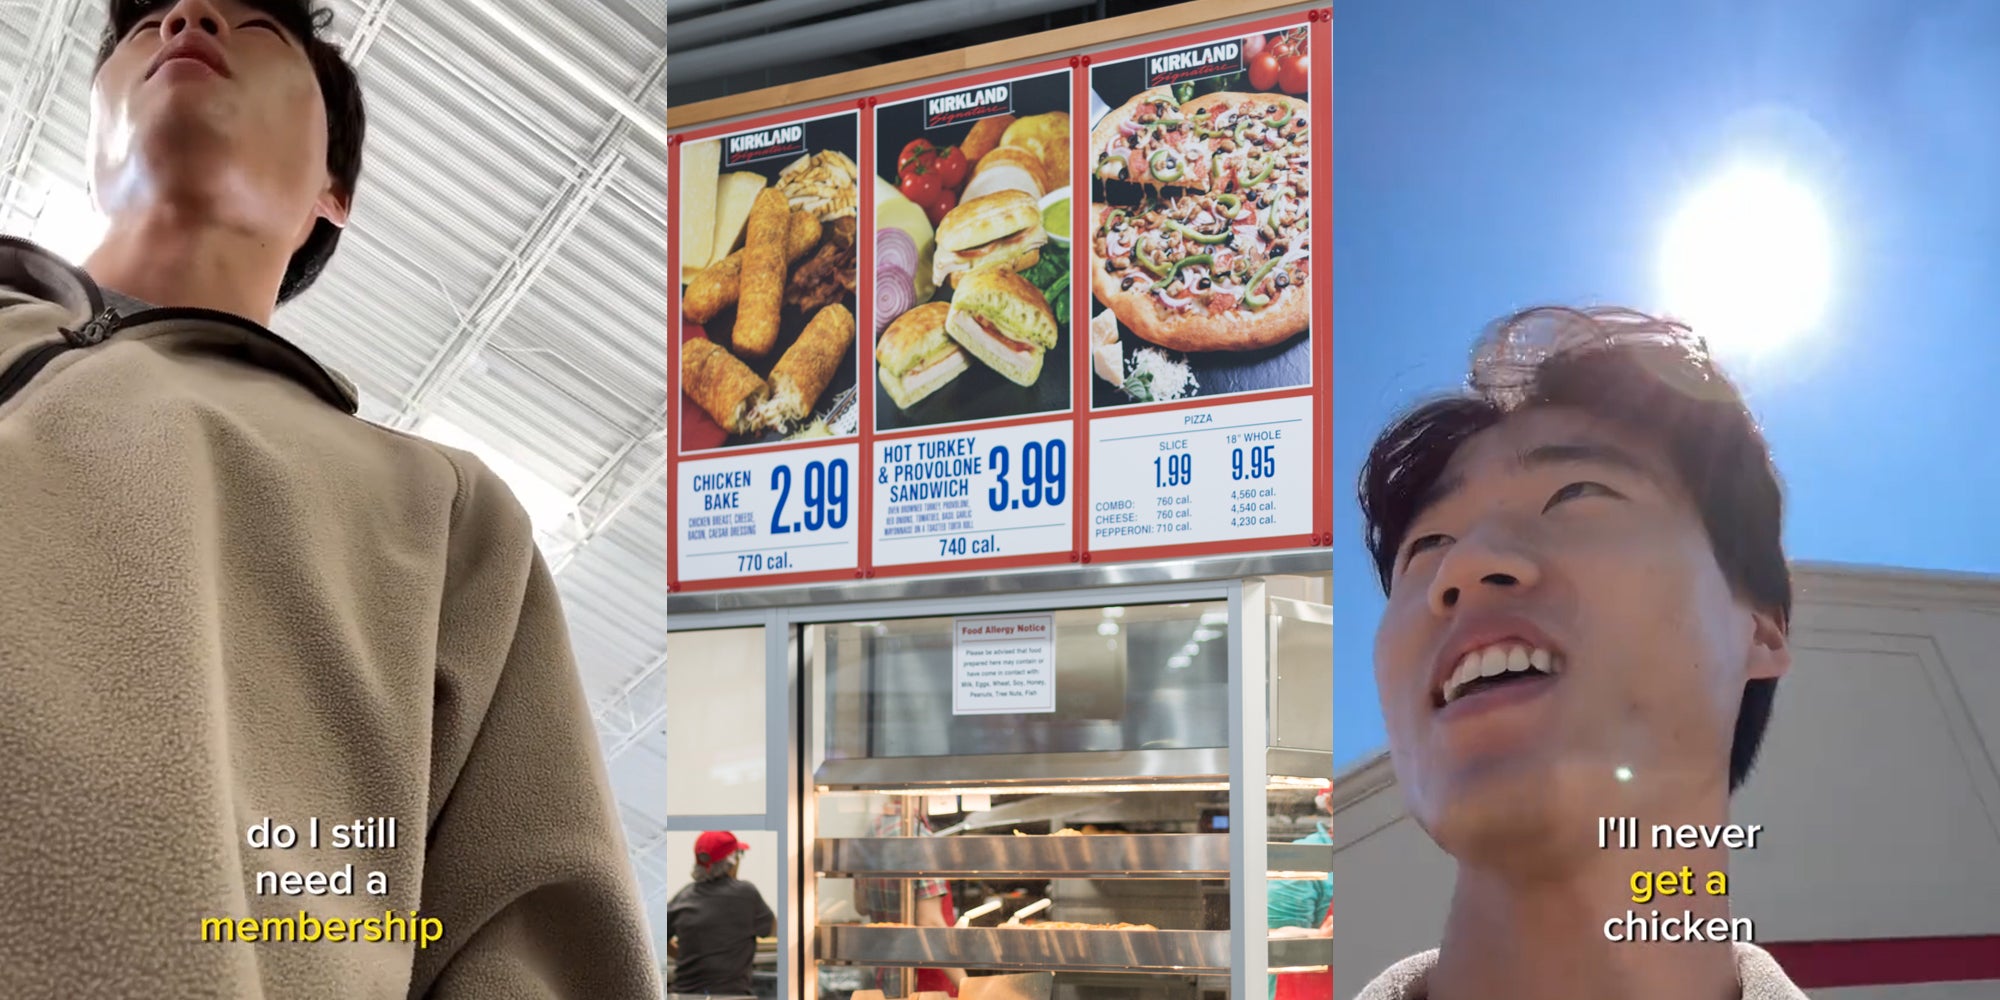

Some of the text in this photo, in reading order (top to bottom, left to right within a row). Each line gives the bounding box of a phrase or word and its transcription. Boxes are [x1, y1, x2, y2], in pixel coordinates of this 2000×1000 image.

[1151, 43, 1239, 75] KIRKLAND
[1151, 63, 1239, 87] Signature
[929, 86, 1008, 116] KIRKLAND
[929, 105, 1009, 126] Signature
[730, 126, 802, 153] KIRKLAND
[1184, 413, 1213, 425] PIZZA
[1159, 440, 1188, 451] SLICE
[1244, 429, 1282, 442] WHOLE
[884, 437, 976, 463] HOT TURKEY
[878, 457, 982, 484] & PROVOLONE
[988, 438, 1066, 512] 3.99
[1154, 453, 1191, 488] 1.99
[1231, 445, 1275, 481] 9.95
[693, 470, 751, 492] CHICKEN
[890, 478, 969, 503] SANDWICH
[704, 492, 740, 511] BAKE
[770, 458, 849, 534] 2.99
[1095, 487, 1276, 512] COMBO: 760 cal. 4,560 cal.
[1095, 501, 1276, 525] CHEESE: 760 cal. 4,540 cal.
[1095, 515, 1276, 538] PEPPERONI: 710 cal. 4,230 cal.
[939, 534, 1001, 556] 740 cal.
[737, 551, 793, 572] 770 cal.
[962, 623, 1046, 636] Food Allergy Notice
